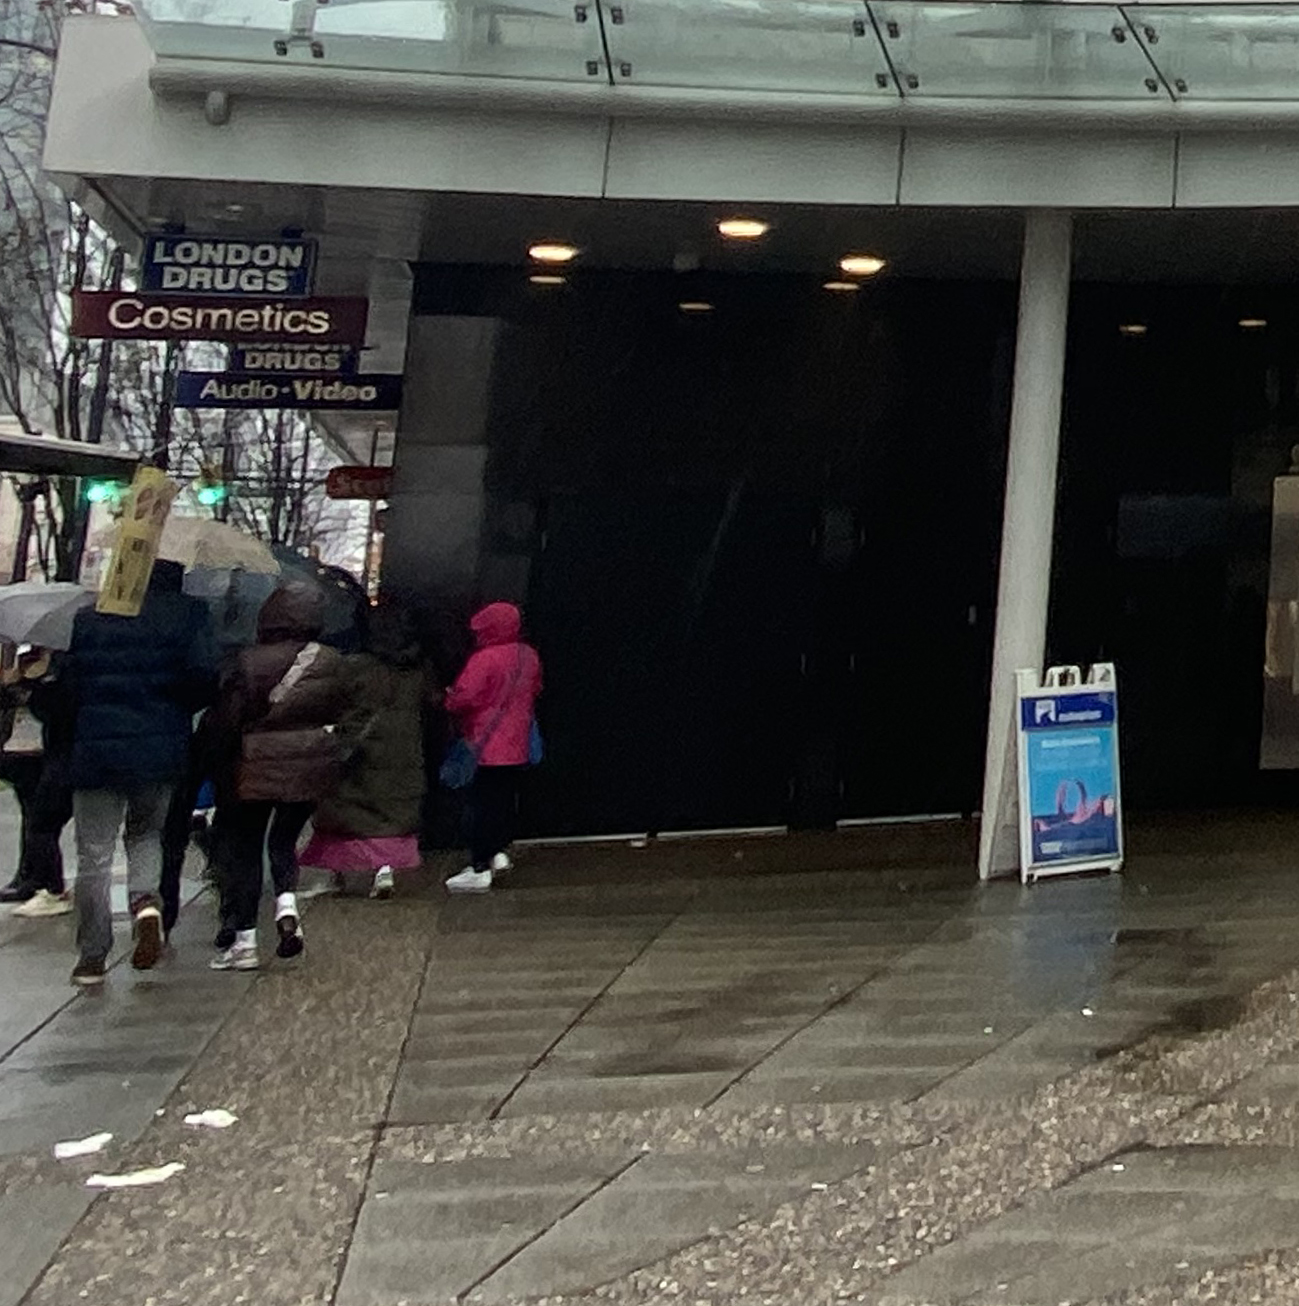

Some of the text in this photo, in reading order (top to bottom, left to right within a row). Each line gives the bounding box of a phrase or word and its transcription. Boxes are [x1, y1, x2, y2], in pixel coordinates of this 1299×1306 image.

[152, 241, 303, 268] LONDON
[162, 265, 291, 293] DRUGS
[108, 298, 331, 335] Cosmetics
[244, 350, 341, 372] DRUGS
